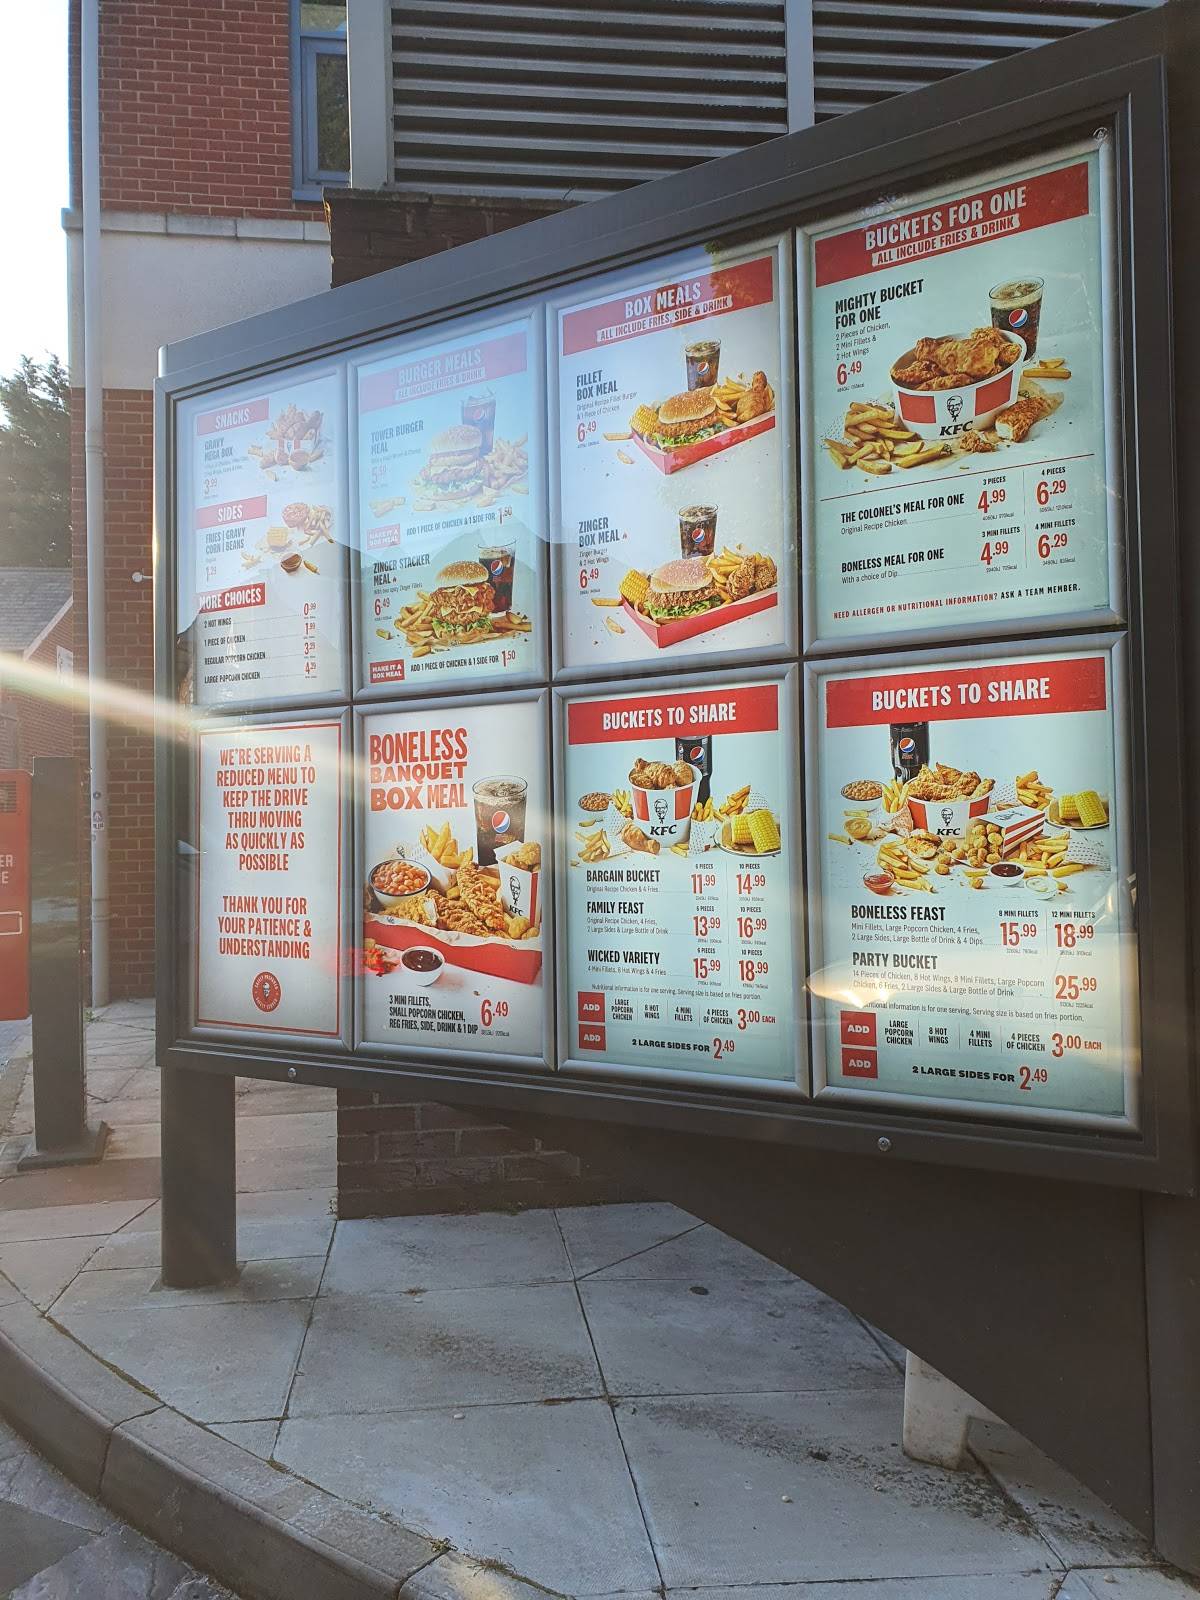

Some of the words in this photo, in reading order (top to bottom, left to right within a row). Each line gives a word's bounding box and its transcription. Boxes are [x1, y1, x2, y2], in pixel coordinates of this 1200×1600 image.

[866, 211, 942, 250] BUCKETS
[949, 200, 982, 227] FOR
[990, 186, 1027, 214] ONE
[878, 250, 893, 264] ALL
[896, 239, 936, 260] INCLUDE
[940, 230, 967, 248] FRIES
[971, 228, 978, 238] &
[982, 216, 1014, 236] DRINK
[625, 296, 652, 318] BOX
[657, 283, 701, 309] MEALS
[835, 292, 876, 314] MIGHTY
[880, 279, 924, 302] BUCKET
[601, 329, 612, 340] ALL
[616, 320, 646, 336] INCLUDE
[674, 310, 692, 321] SIDE
[695, 307, 700, 315] &
[703, 301, 728, 313] DRINK
[835, 313, 856, 329] FOR
[860, 306, 881, 323] ONE
[399, 360, 440, 385] BURGER
[577, 370, 602, 387] FILLET
[837, 361, 862, 385] 6.49
[577, 386, 593, 401] BOX
[596, 380, 618, 396] MEAL
[216, 408, 250, 429] SNACKS
[940, 421, 973, 436] KFC
[578, 421, 596, 442] 6.49
[978, 489, 1006, 513] 4.99
[1037, 480, 1066, 505] 6.29
[218, 505, 243, 521] SIDES
[841, 512, 856, 523] THE
[859, 504, 901, 520] COLONEL'S
[904, 500, 925, 513] MEAL
[928, 497, 944, 509] FOR
[947, 494, 964, 505] ONE
[206, 532, 221, 544] FRIES
[226, 527, 246, 540] GRAVY
[579, 517, 608, 533] ZINGER
[841, 524, 862, 535] Original
[864, 522, 883, 531] Recipe
[885, 519, 907, 528] Chicken
[579, 534, 595, 547] BOX
[599, 529, 620, 544] MEAL
[1038, 533, 1067, 558] 6.29
[373, 561, 397, 573] ZINGER
[399, 554, 430, 568] STACKER
[842, 558, 881, 573] BONELESS
[884, 554, 905, 566] MEAL
[908, 552, 924, 563] FOR
[928, 548, 944, 560] ONE
[981, 541, 1008, 565] 4.99
[374, 574, 390, 586] MEAL
[580, 568, 599, 588] 6.49
[199, 593, 222, 610] MORE
[225, 588, 261, 607] CHOICES
[374, 598, 390, 616] 6.49
[834, 611, 849, 619] NEED
[852, 607, 884, 617] ALLERGEN
[887, 605, 895, 613] OR
[898, 599, 942, 611] NUTRITIONAL
[946, 593, 998, 605] INFORMATION?
[1001, 590, 1014, 599] ASK
[1025, 588, 1044, 596] TEAM
[1047, 584, 1081, 594] MEMBER.
[872, 685, 951, 711] BUCKETS
[958, 683, 981, 704] TO
[988, 677, 1050, 702] SHARE
[603, 709, 662, 730] BUCKETS
[667, 707, 684, 725] TO
[689, 702, 736, 723] SHARE
[220, 748, 251, 765] WE'RE
[254, 746, 300, 764] SERVING
[304, 745, 311, 761] A
[370, 728, 468, 765] BONELESS
[217, 769, 264, 786] REDUCED
[268, 767, 297, 785] MENU
[301, 766, 315, 783] TO
[371, 762, 467, 784] BANQUET
[223, 791, 248, 807] KEEP
[251, 790, 271, 806] THE
[274, 788, 308, 806] DRIVE
[371, 786, 423, 812] BOX
[427, 784, 468, 808] MEAL
[228, 812, 256, 828] THRU
[259, 811, 302, 828] MOVING
[650, 825, 677, 835] KFC
[226, 833, 238, 849] AS
[241, 832, 287, 851] QUICKLY
[291, 832, 304, 849] AS
[937, 828, 960, 836] KFC
[240, 854, 289, 870] POSSIBLE
[587, 870, 623, 882] BARGAIN
[627, 870, 660, 882] BUCKET
[691, 874, 716, 894] 11.99
[736, 874, 765, 894] 14.99
[223, 896, 258, 913] THANK
[261, 897, 282, 914] YOU
[286, 897, 307, 914] FOR
[509, 905, 523, 916] KFC
[587, 902, 615, 913] FAMILY
[619, 902, 644, 914] FEAST
[852, 905, 907, 919] BONELESS
[911, 906, 945, 920] FEAST
[218, 916, 245, 933] YOUR
[248, 918, 300, 936] PATIENCE
[304, 920, 311, 937] &
[693, 916, 720, 936] 13.99
[737, 917, 767, 938] 16.99
[886, 924, 901, 932] Large
[904, 925, 928, 933] Popcorn
[1000, 922, 1036, 946] 15.99
[1055, 924, 1094, 948] 18.99
[220, 938, 309, 959] UNDERSTANDING
[588, 950, 620, 962] WICKED
[623, 951, 659, 964] VARIETY
[693, 958, 720, 978] 15.99
[739, 960, 768, 981] 18.99
[853, 952, 888, 967] PARTY
[893, 954, 937, 969] BUCKET
[1055, 975, 1097, 1000] 25.99
[389, 995, 393, 1005] 3
[395, 995, 406, 1006] MINI
[407, 996, 431, 1007] FILLETS,
[583, 1003, 600, 1011] ADD
[389, 1007, 407, 1018] SMALL
[409, 1008, 436, 1019] POPCORN
[438, 1010, 465, 1022] CHICKEN,
[481, 999, 508, 1027] 6.49
[738, 1009, 760, 1030] 3.00
[848, 1025, 869, 1033] ADD
[638, 1039, 665, 1049] LARGE
[667, 1042, 691, 1050] SIDES
[693, 1044, 710, 1052] FOR
[714, 1038, 735, 1059] 2.49
[1052, 1033, 1081, 1057] 3.00
[1084, 1042, 1102, 1050] EACH
[921, 1067, 956, 1077] LARGE
[959, 1070, 990, 1079] SIDES
[993, 1073, 1015, 1082] FOR
[1020, 1066, 1048, 1090] 2.49
